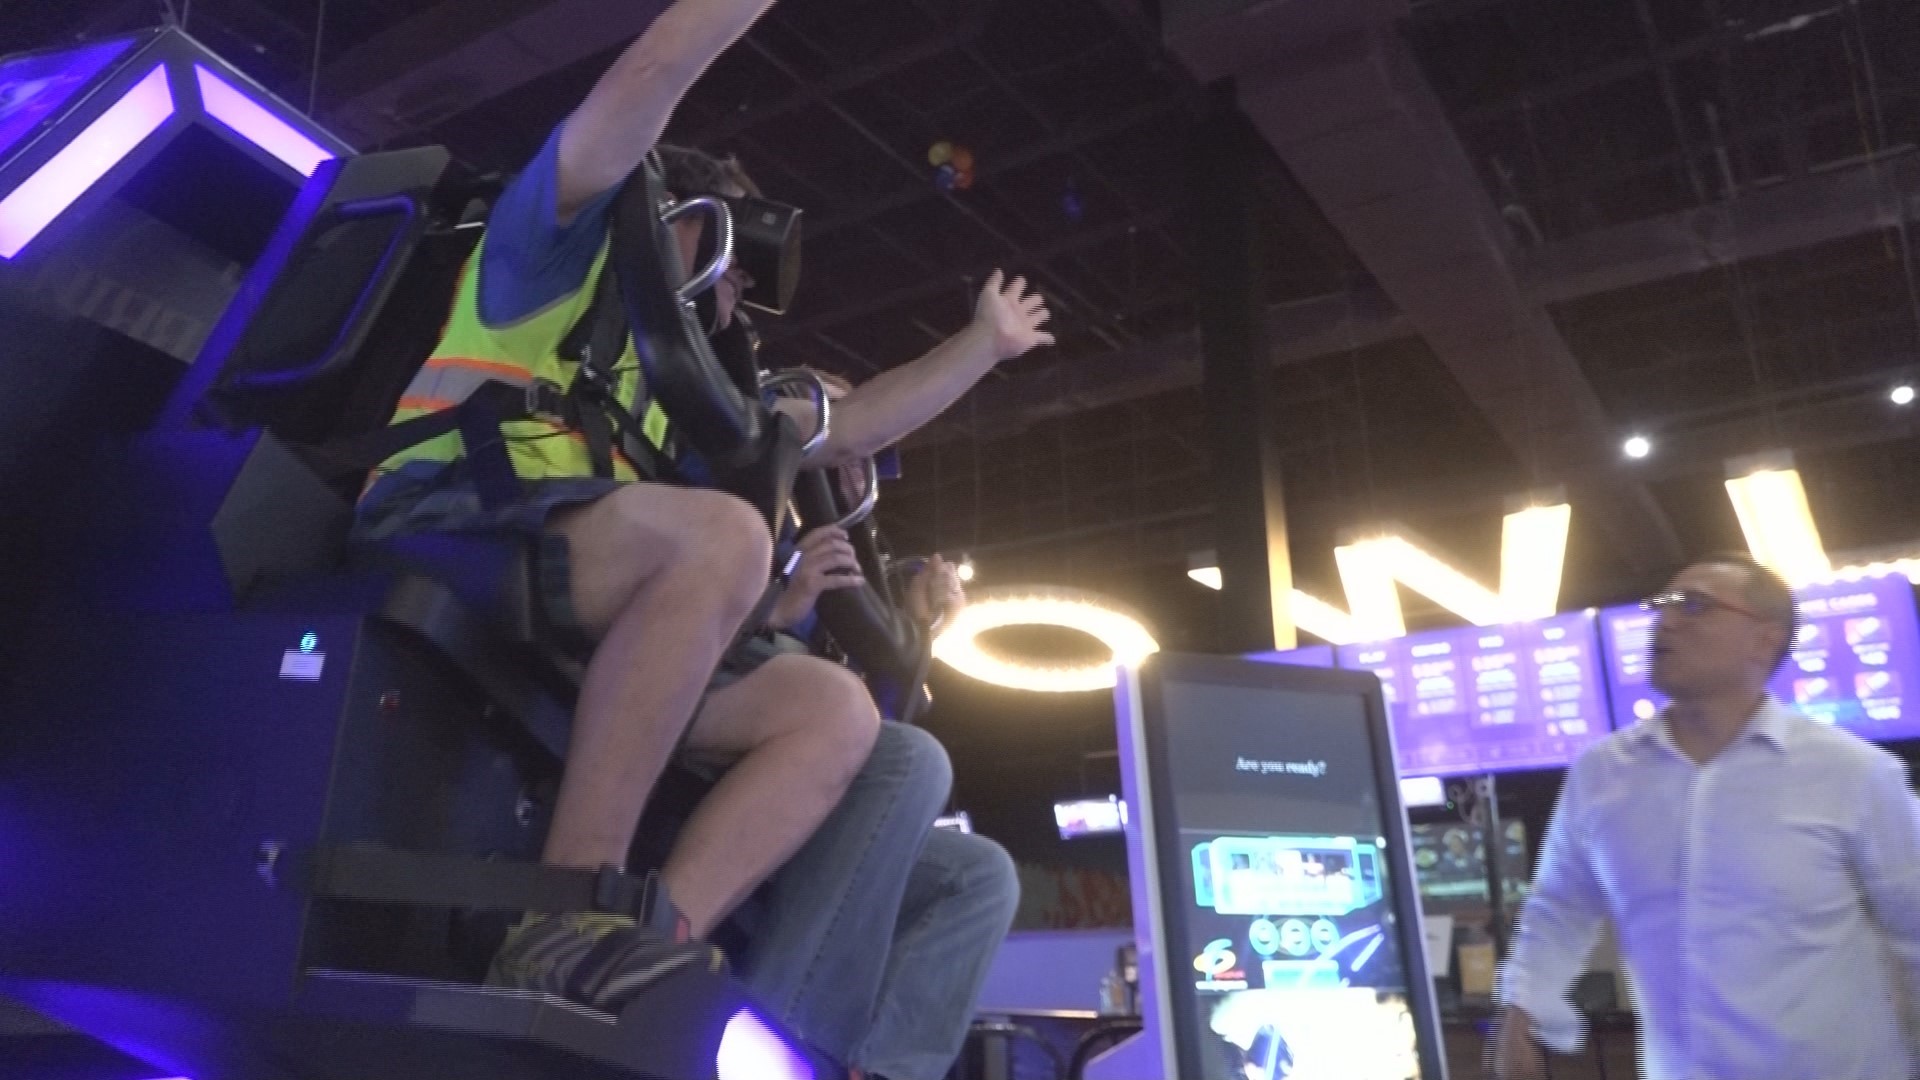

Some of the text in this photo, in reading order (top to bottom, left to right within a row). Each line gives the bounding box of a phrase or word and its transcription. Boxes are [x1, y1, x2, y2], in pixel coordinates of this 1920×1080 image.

[1235, 756, 1327, 777] Are you ready?
